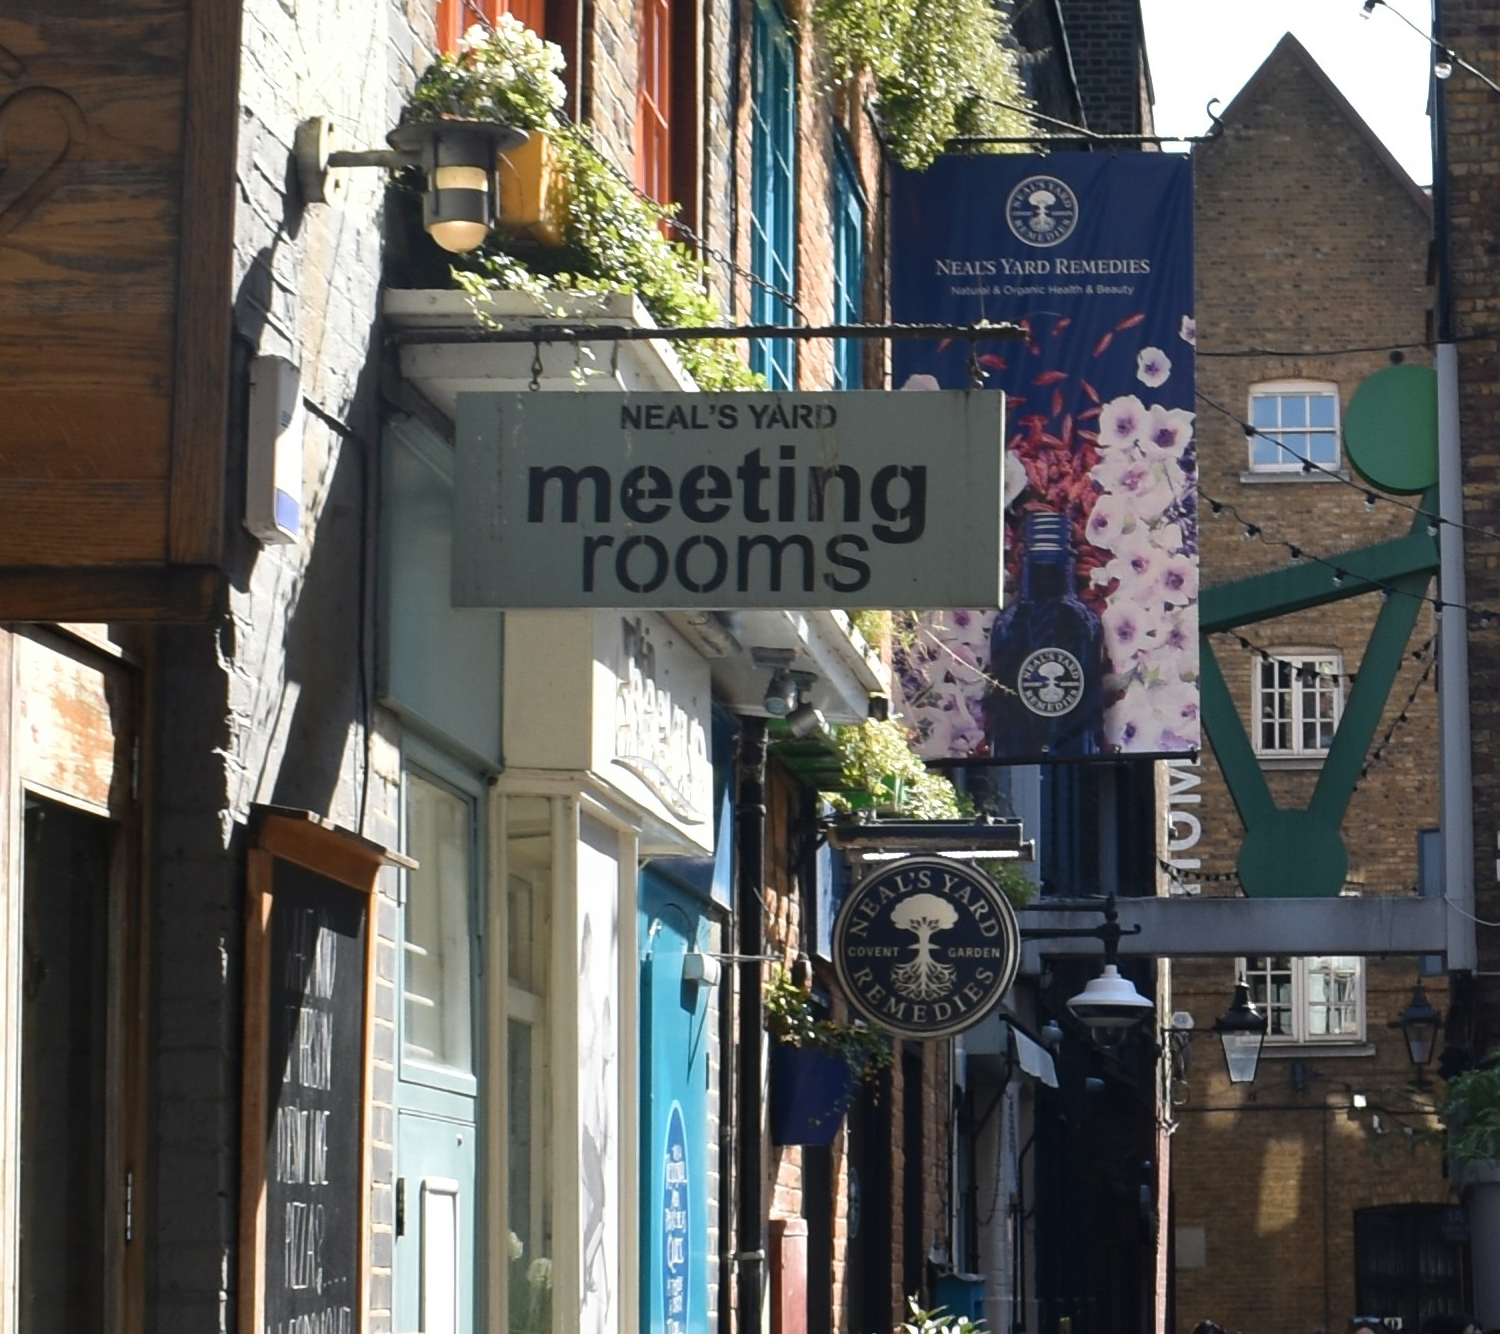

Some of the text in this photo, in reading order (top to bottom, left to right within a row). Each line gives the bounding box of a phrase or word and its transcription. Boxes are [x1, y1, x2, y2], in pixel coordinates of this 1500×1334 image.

[1013, 218, 1072, 242] REMEDIES
[1000, 259, 1050, 275] YARD
[1055, 258, 1151, 275] REMEDIES
[951, 284, 1135, 297] Natural & Organic Health & Beauty
[620, 404, 838, 431] NEAL'S YARD
[526, 444, 928, 545] meeting
[582, 532, 871, 594] rooms
[851, 870, 1000, 938] NEAL'S YARD
[847, 946, 1001, 958] COVENT GARDEN
[853, 966, 994, 1023] REMEDIES
